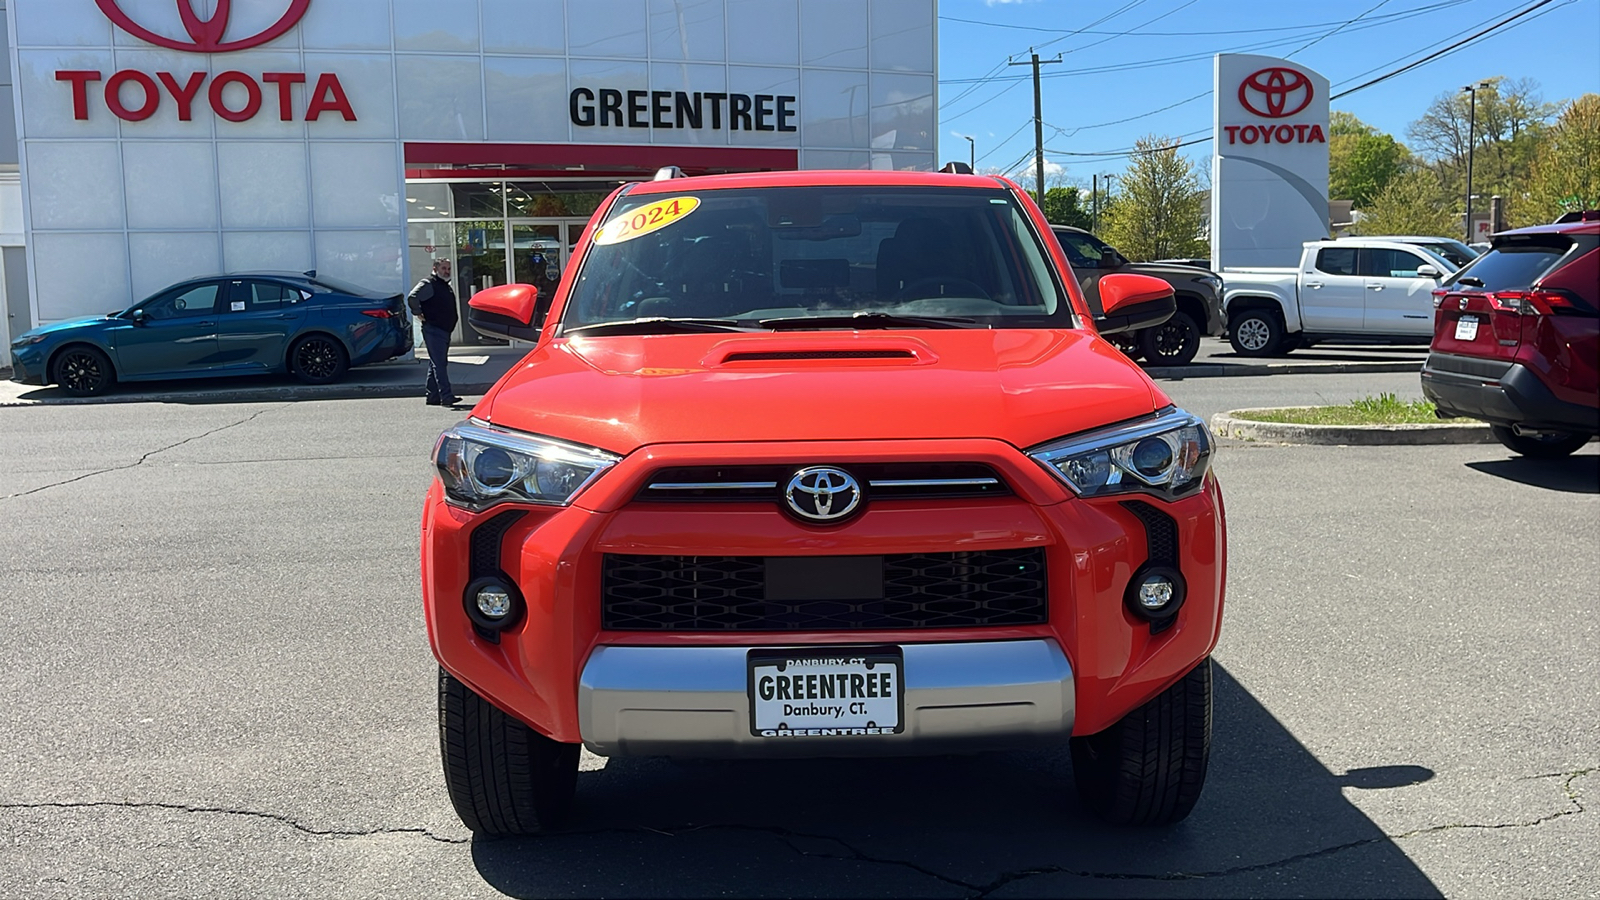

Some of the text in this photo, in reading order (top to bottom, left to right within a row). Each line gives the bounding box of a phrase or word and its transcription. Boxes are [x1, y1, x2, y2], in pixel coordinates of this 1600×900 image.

[55, 70, 357, 122] TOYOTA
[569, 87, 798, 133] GREENTREE
[1224, 124, 1326, 145] TOYOTA
[616, 200, 683, 240] 2024
[759, 673, 892, 701] GREENTREE
[783, 702, 868, 718] Danbury, CT.
[761, 727, 895, 737] GREENTREE
